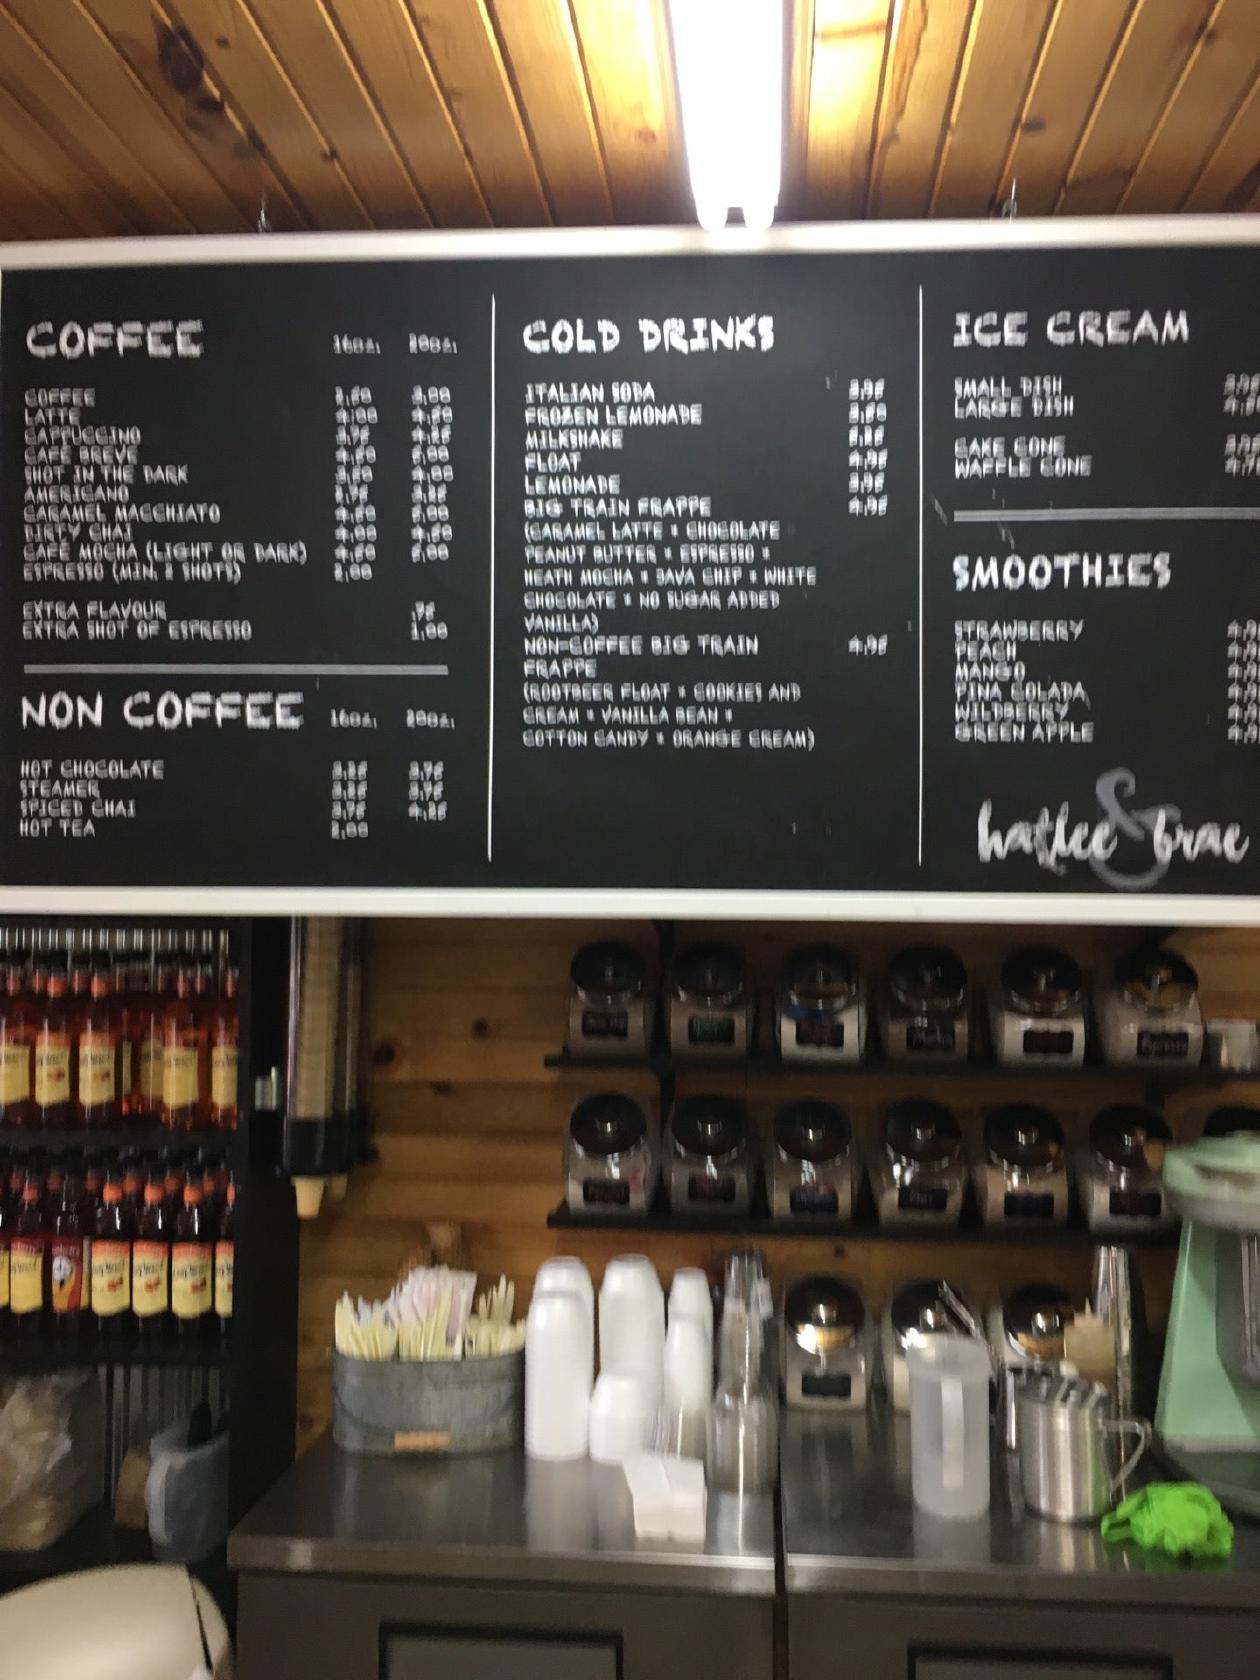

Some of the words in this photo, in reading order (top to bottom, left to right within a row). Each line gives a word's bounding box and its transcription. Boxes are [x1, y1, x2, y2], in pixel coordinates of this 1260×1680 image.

[26, 320, 204, 359] COFFEE
[523, 318, 620, 354] COLD
[638, 313, 774, 354] DRINKS
[953, 311, 1028, 348] ICE
[1046, 309, 1190, 347] CREAM
[24, 387, 95, 406] COFFEE
[525, 382, 604, 404] ITALIAN
[611, 382, 655, 403] SODA
[954, 376, 1012, 399] SMALL
[1020, 375, 1062, 398] DISH
[24, 407, 81, 426] LATTE
[335, 406, 378, 426] 4.00
[525, 405, 599, 426] FROZEN
[606, 403, 703, 426] LEMONADE
[954, 396, 1022, 419] LARGE
[1032, 395, 1074, 417] DISH
[24, 426, 141, 445] CAPPUCCINO
[525, 428, 624, 450] MILKSHAKE
[954, 436, 1005, 458] CAKE
[1014, 435, 1066, 458] CONE
[79, 445, 139, 465] BREVE
[525, 451, 582, 473] FLOAT
[24, 465, 65, 484] SHOT
[73, 465, 94, 484] IN
[100, 465, 134, 484] THE
[143, 465, 189, 486] DARK
[411, 464, 454, 484] 4.00
[955, 456, 1031, 479] WAFFLE
[1040, 454, 1093, 477] CONE
[24, 484, 130, 502] AMERICANO
[525, 474, 620, 495] LEMONADE
[24, 504, 107, 523] CARAMEL
[114, 503, 221, 524] MACCHIATO
[525, 497, 563, 518] BIG
[570, 496, 630, 518] TRAIN
[638, 495, 711, 518] FRAPPE
[24, 523, 81, 542] DIRTY
[89, 523, 133, 542] CHAI
[335, 524, 377, 543] 4.00
[524, 520, 605, 543] (CARAMEL
[612, 520, 663, 542] LATTE
[686, 519, 780, 541] CHOCOLATE
[79, 542, 139, 562] MOCHA
[146, 541, 213, 563] (LIGHT
[221, 542, 245, 564] OR
[254, 542, 307, 565] DARK)
[524, 544, 586, 565] PEANUT
[593, 544, 657, 565] BUTTER
[680, 543, 755, 564] ESPRESSO
[23, 562, 103, 582] ESPRESSO
[182, 561, 241, 584] SHOTS)
[524, 567, 573, 587] HEATH
[580, 567, 634, 587] MOCHA
[656, 566, 695, 587] JAVA
[702, 566, 743, 586] CHIP
[764, 565, 817, 586] WHITE
[953, 552, 1171, 591] SMOOTHIES
[23, 601, 79, 621] EXTRA
[87, 600, 166, 621] FLAVOUR
[523, 590, 617, 611] CHOCOLATE
[639, 590, 660, 610] NO
[667, 589, 722, 611] SUGAR
[727, 589, 780, 609] ADDED
[23, 621, 79, 640] EXTRA
[87, 621, 129, 640] SHOT
[137, 621, 160, 640] OF
[169, 620, 252, 640] ESPRESSO
[412, 621, 448, 641] 1.00
[523, 613, 599, 634] VANILLA)
[954, 619, 1084, 642] STRAWBERRY
[524, 635, 643, 656] NON-COFFEE
[651, 635, 690, 656] BIG
[697, 635, 759, 656] TRAIN
[955, 640, 1017, 661] PEACH
[523, 658, 598, 680] FRAPPE
[955, 660, 1026, 681] MANGO
[523, 682, 614, 704] (ROOTBEER
[621, 682, 671, 702] FLOAT
[694, 682, 762, 703] COOKIES
[768, 682, 801, 702] AND
[1011, 681, 1085, 702] COLADA
[22, 691, 102, 729] NON
[124, 691, 304, 729] COFFEE
[523, 706, 579, 726] CREAM
[601, 704, 669, 726] VANILLA
[676, 705, 718, 725] BEAN
[955, 701, 1070, 722] WILDBERRY
[523, 729, 587, 748] COTTON
[594, 728, 648, 748] CANDY
[673, 728, 742, 749] ORANGE
[749, 727, 815, 752] CREAM)
[955, 722, 1025, 742] GREEN
[1032, 721, 1094, 743] APPLE
[20, 760, 52, 779] HOT
[61, 760, 164, 779] CHOCOLATE
[20, 780, 100, 799] STEAMER
[20, 800, 83, 818] SPICED
[92, 799, 136, 819] CHAI
[20, 819, 52, 838] HOT
[60, 819, 96, 838] TEA
[1089, 766, 1182, 892] &
